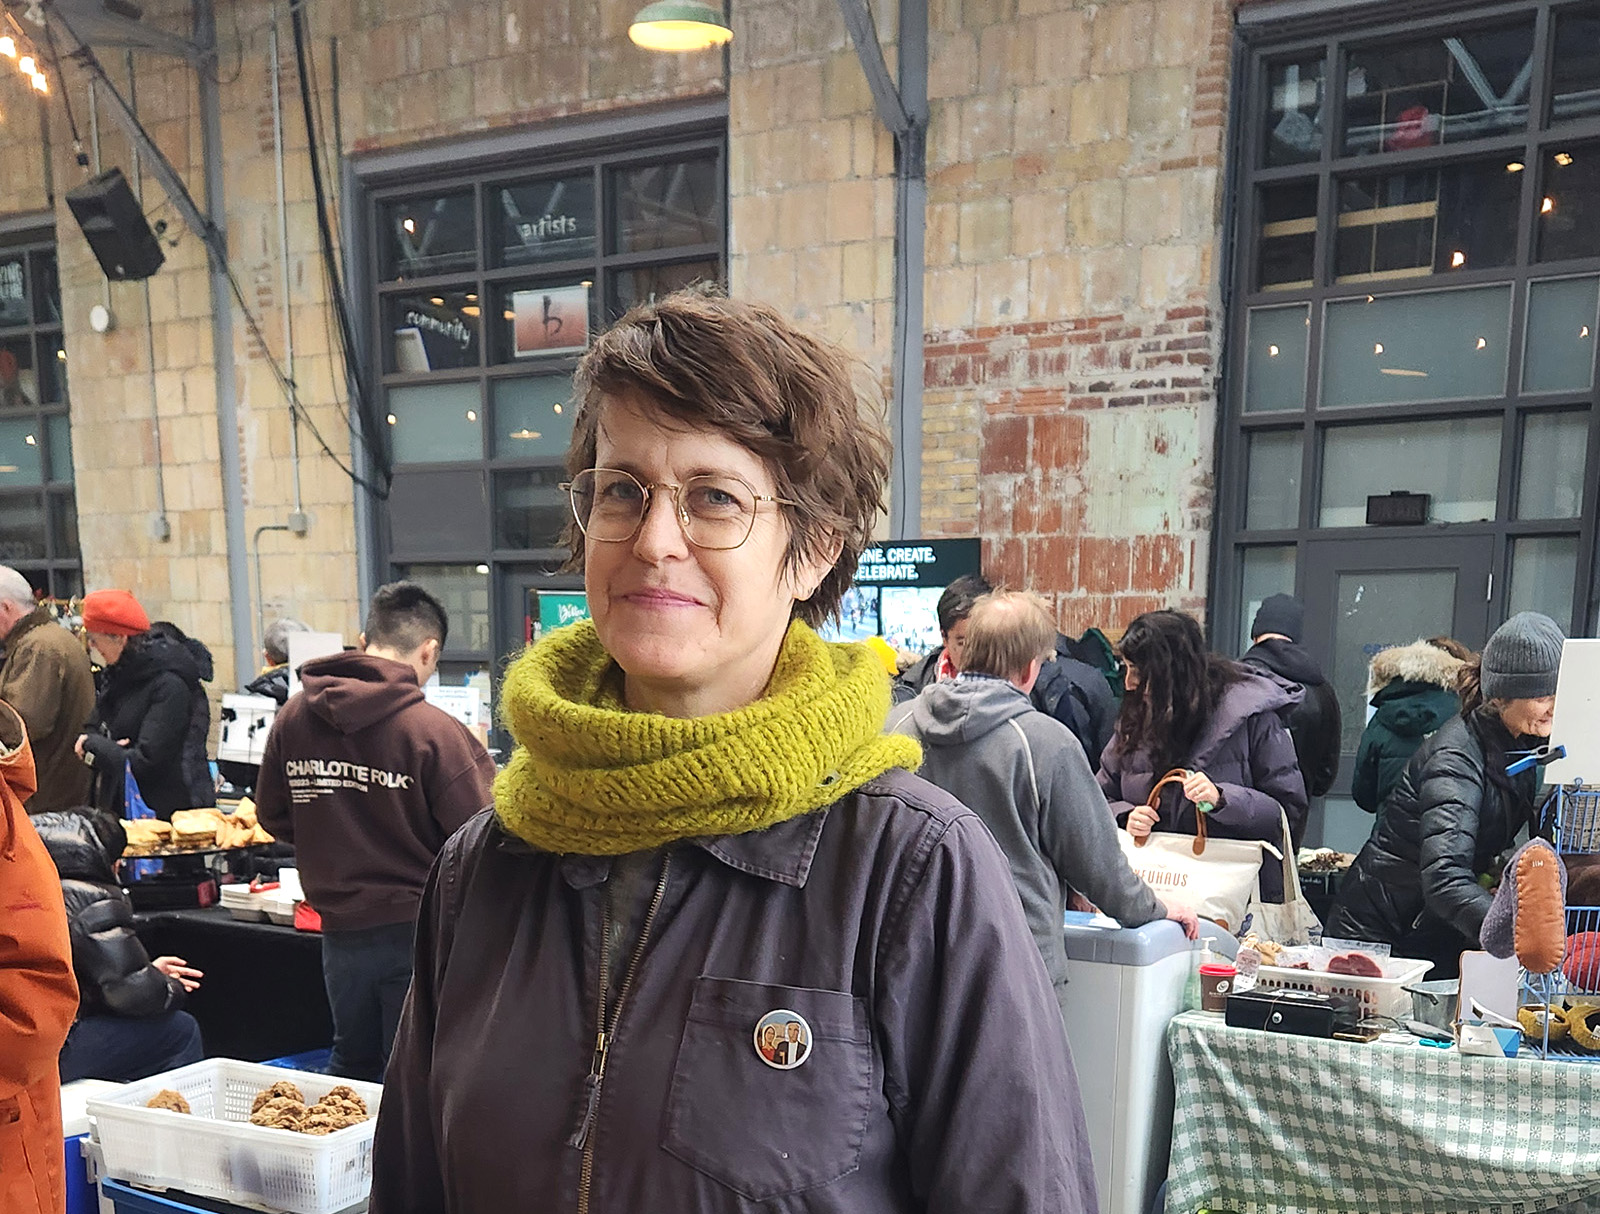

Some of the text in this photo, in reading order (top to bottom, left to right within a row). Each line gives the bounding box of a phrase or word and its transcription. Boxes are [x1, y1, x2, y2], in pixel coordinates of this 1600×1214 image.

[520, 215, 577, 237] artists
[407, 311, 471, 349] community
[887, 547, 937, 563] CREATE.
[286, 759, 369, 782] CHARLOTTE
